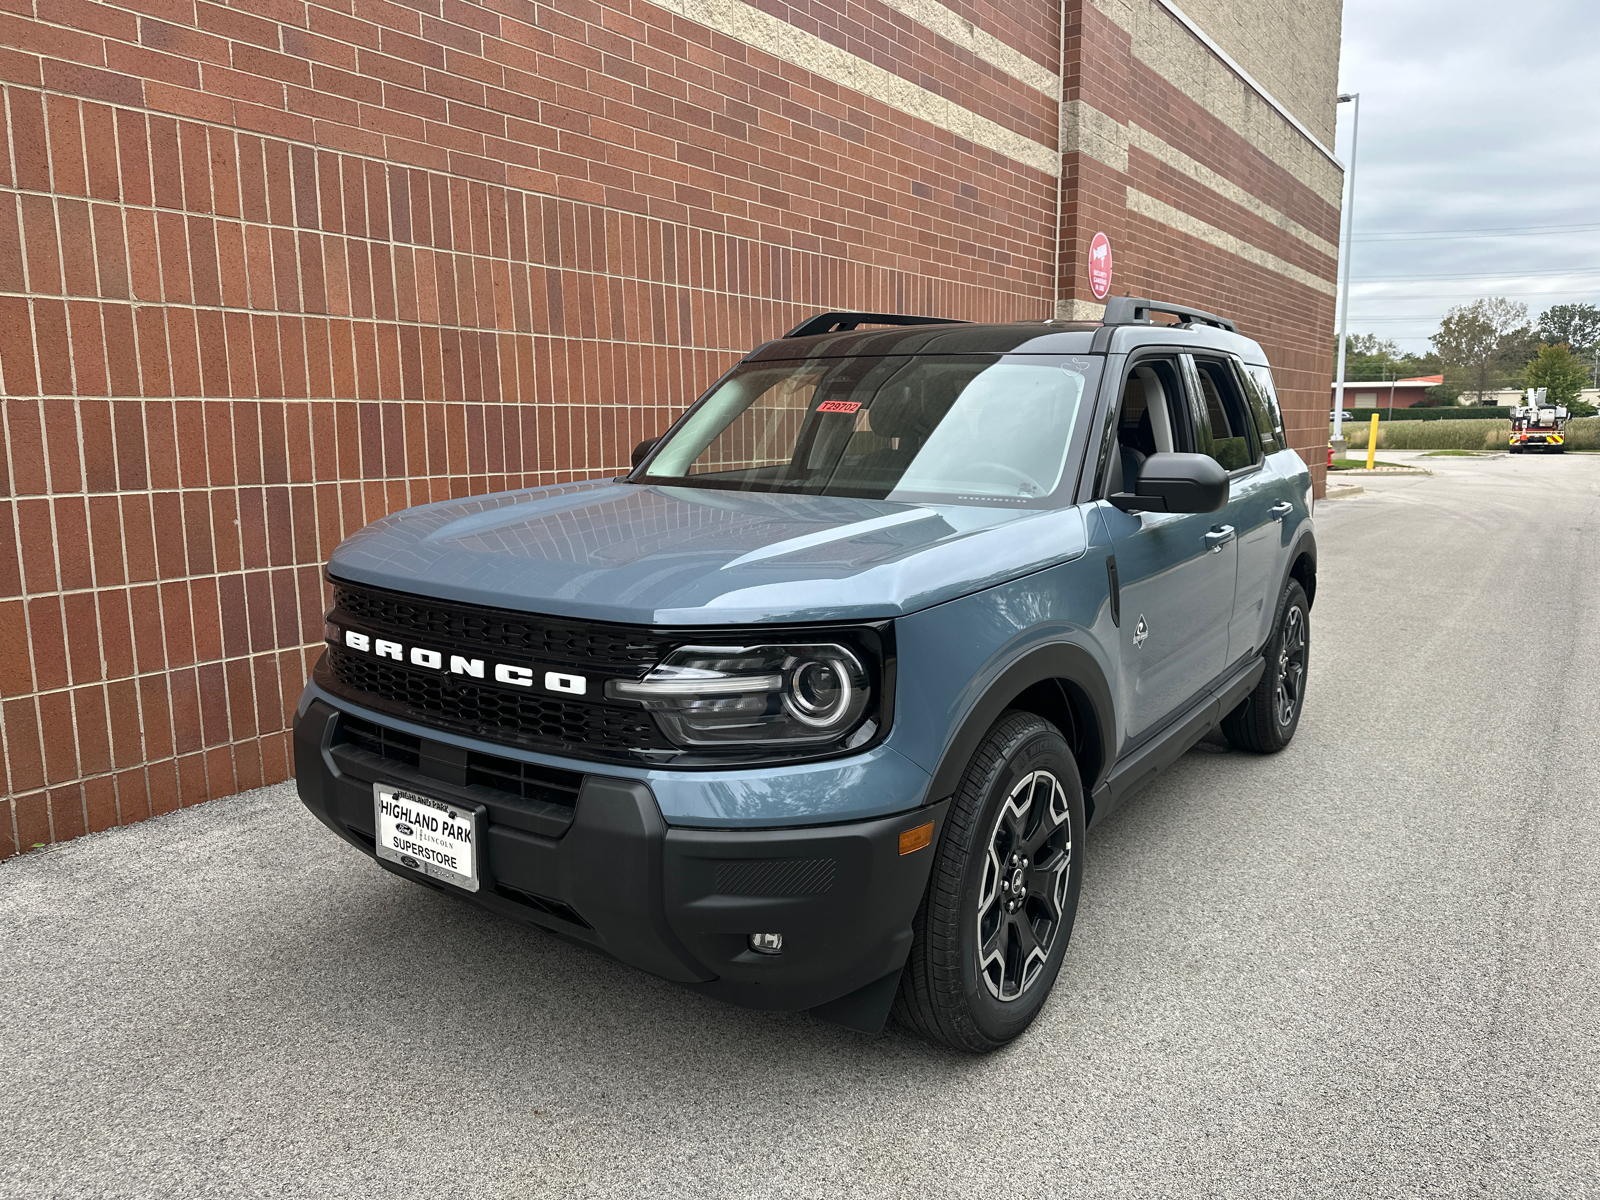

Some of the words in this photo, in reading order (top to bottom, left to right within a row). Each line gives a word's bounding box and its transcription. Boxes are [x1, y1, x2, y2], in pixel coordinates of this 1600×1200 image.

[822, 402, 858, 411] T29702
[345, 630, 587, 695] BRONCO
[397, 790, 431, 807] HIGHLAND
[432, 800, 449, 813] PARK
[380, 800, 438, 832] HIGHLAND
[442, 821, 472, 844] PARK
[393, 836, 458, 870] SUPERSTORE
[424, 833, 454, 849] LINCOLN
